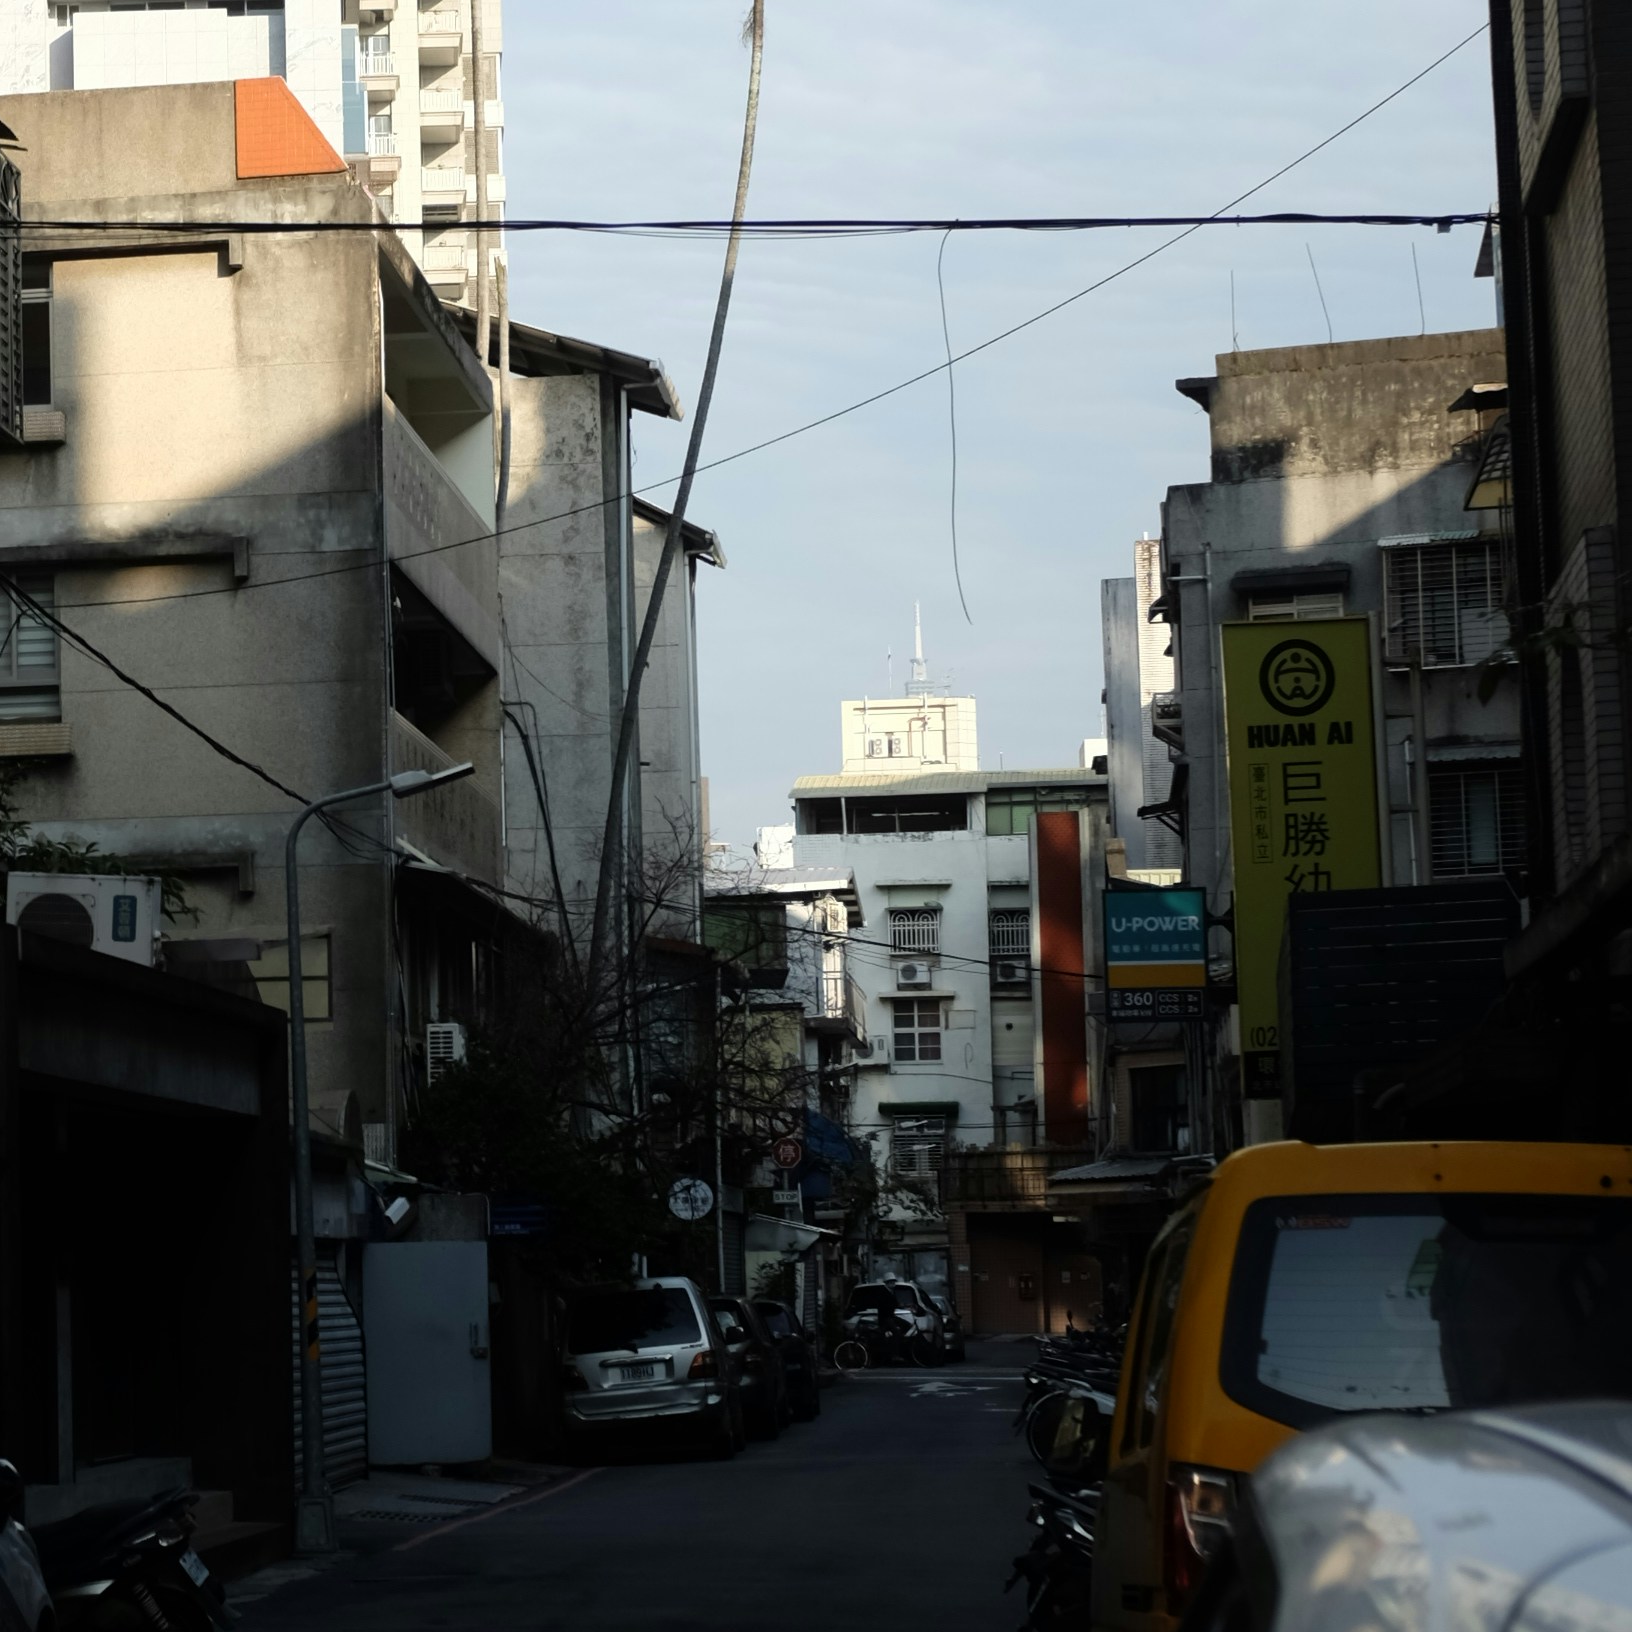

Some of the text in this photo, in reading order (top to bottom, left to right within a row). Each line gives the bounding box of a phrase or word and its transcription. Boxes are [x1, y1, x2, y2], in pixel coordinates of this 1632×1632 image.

[1247, 721, 1353, 748] HUAN AI
[1282, 760, 1331, 894] 巨勝幼
[1111, 915, 1200, 933] U-POWER
[1123, 992, 1153, 1006] 360
[779, 1145, 795, 1162] 停
[774, 1193, 798, 1201] STOP
